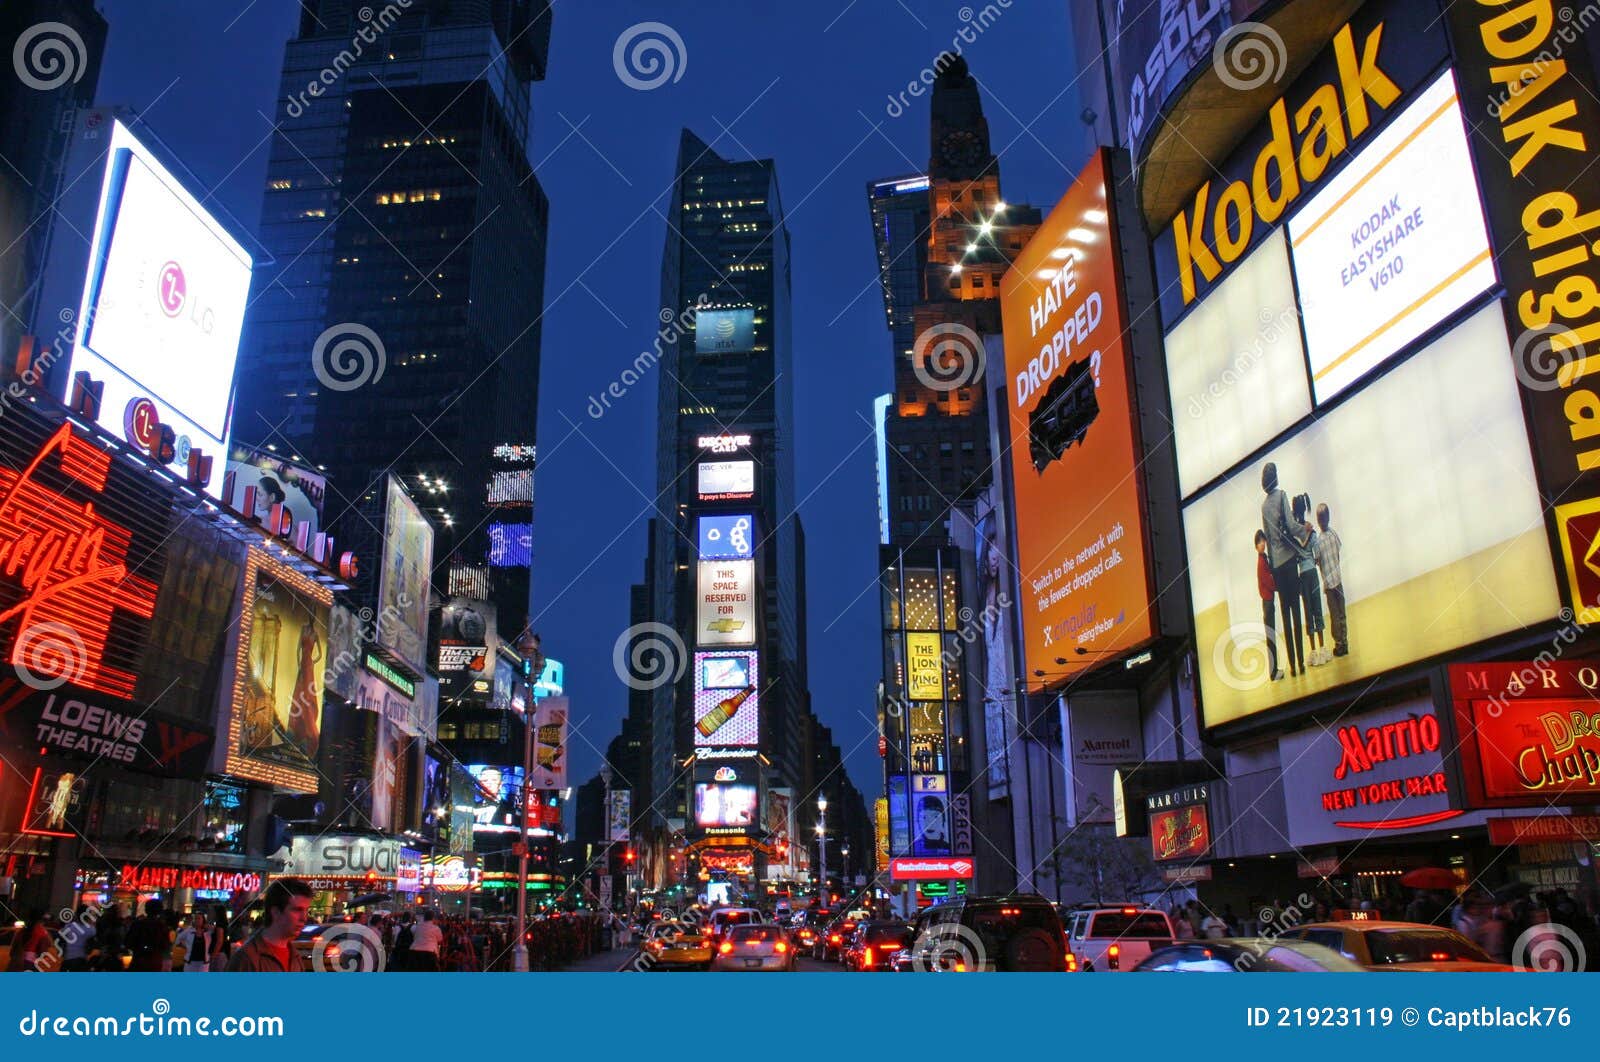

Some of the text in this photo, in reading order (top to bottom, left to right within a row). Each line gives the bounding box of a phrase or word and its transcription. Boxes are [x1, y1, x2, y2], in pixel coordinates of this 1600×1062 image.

[1475, 0, 1587, 178] DAK
[1173, 21, 1402, 306] Kodak
[1351, 193, 1402, 249] KODAK
[1341, 206, 1424, 288] EASYSHARE
[1370, 256, 1404, 291] V610
[1030, 256, 1078, 337] HATE
[1017, 291, 1102, 407] DROPPED
[716, 570, 735, 578] THIS
[1033, 521, 1124, 595] Switch to the network with
[705, 594, 746, 603] RESERVED
[712, 582, 738, 591] SPACE
[1039, 596, 1050, 612] the
[1049, 581, 1072, 605] fewest
[1072, 557, 1103, 589] dropped
[717, 605, 734, 614] FOR
[1054, 602, 1096, 641] cingular
[911, 656, 937, 673] LION
[914, 645, 934, 654] THE
[912, 674, 939, 690] KING
[41, 694, 148, 743] LOEWS
[36, 723, 138, 763] THEATRES
[695, 747, 758, 759] Budweiser
[1148, 786, 1208, 809] MARQUIS
[1322, 772, 1448, 811] NEW YORK MAR
[956, 796, 971, 850] PEACE
[121, 863, 262, 892] PLANET HOLLYWOOD
